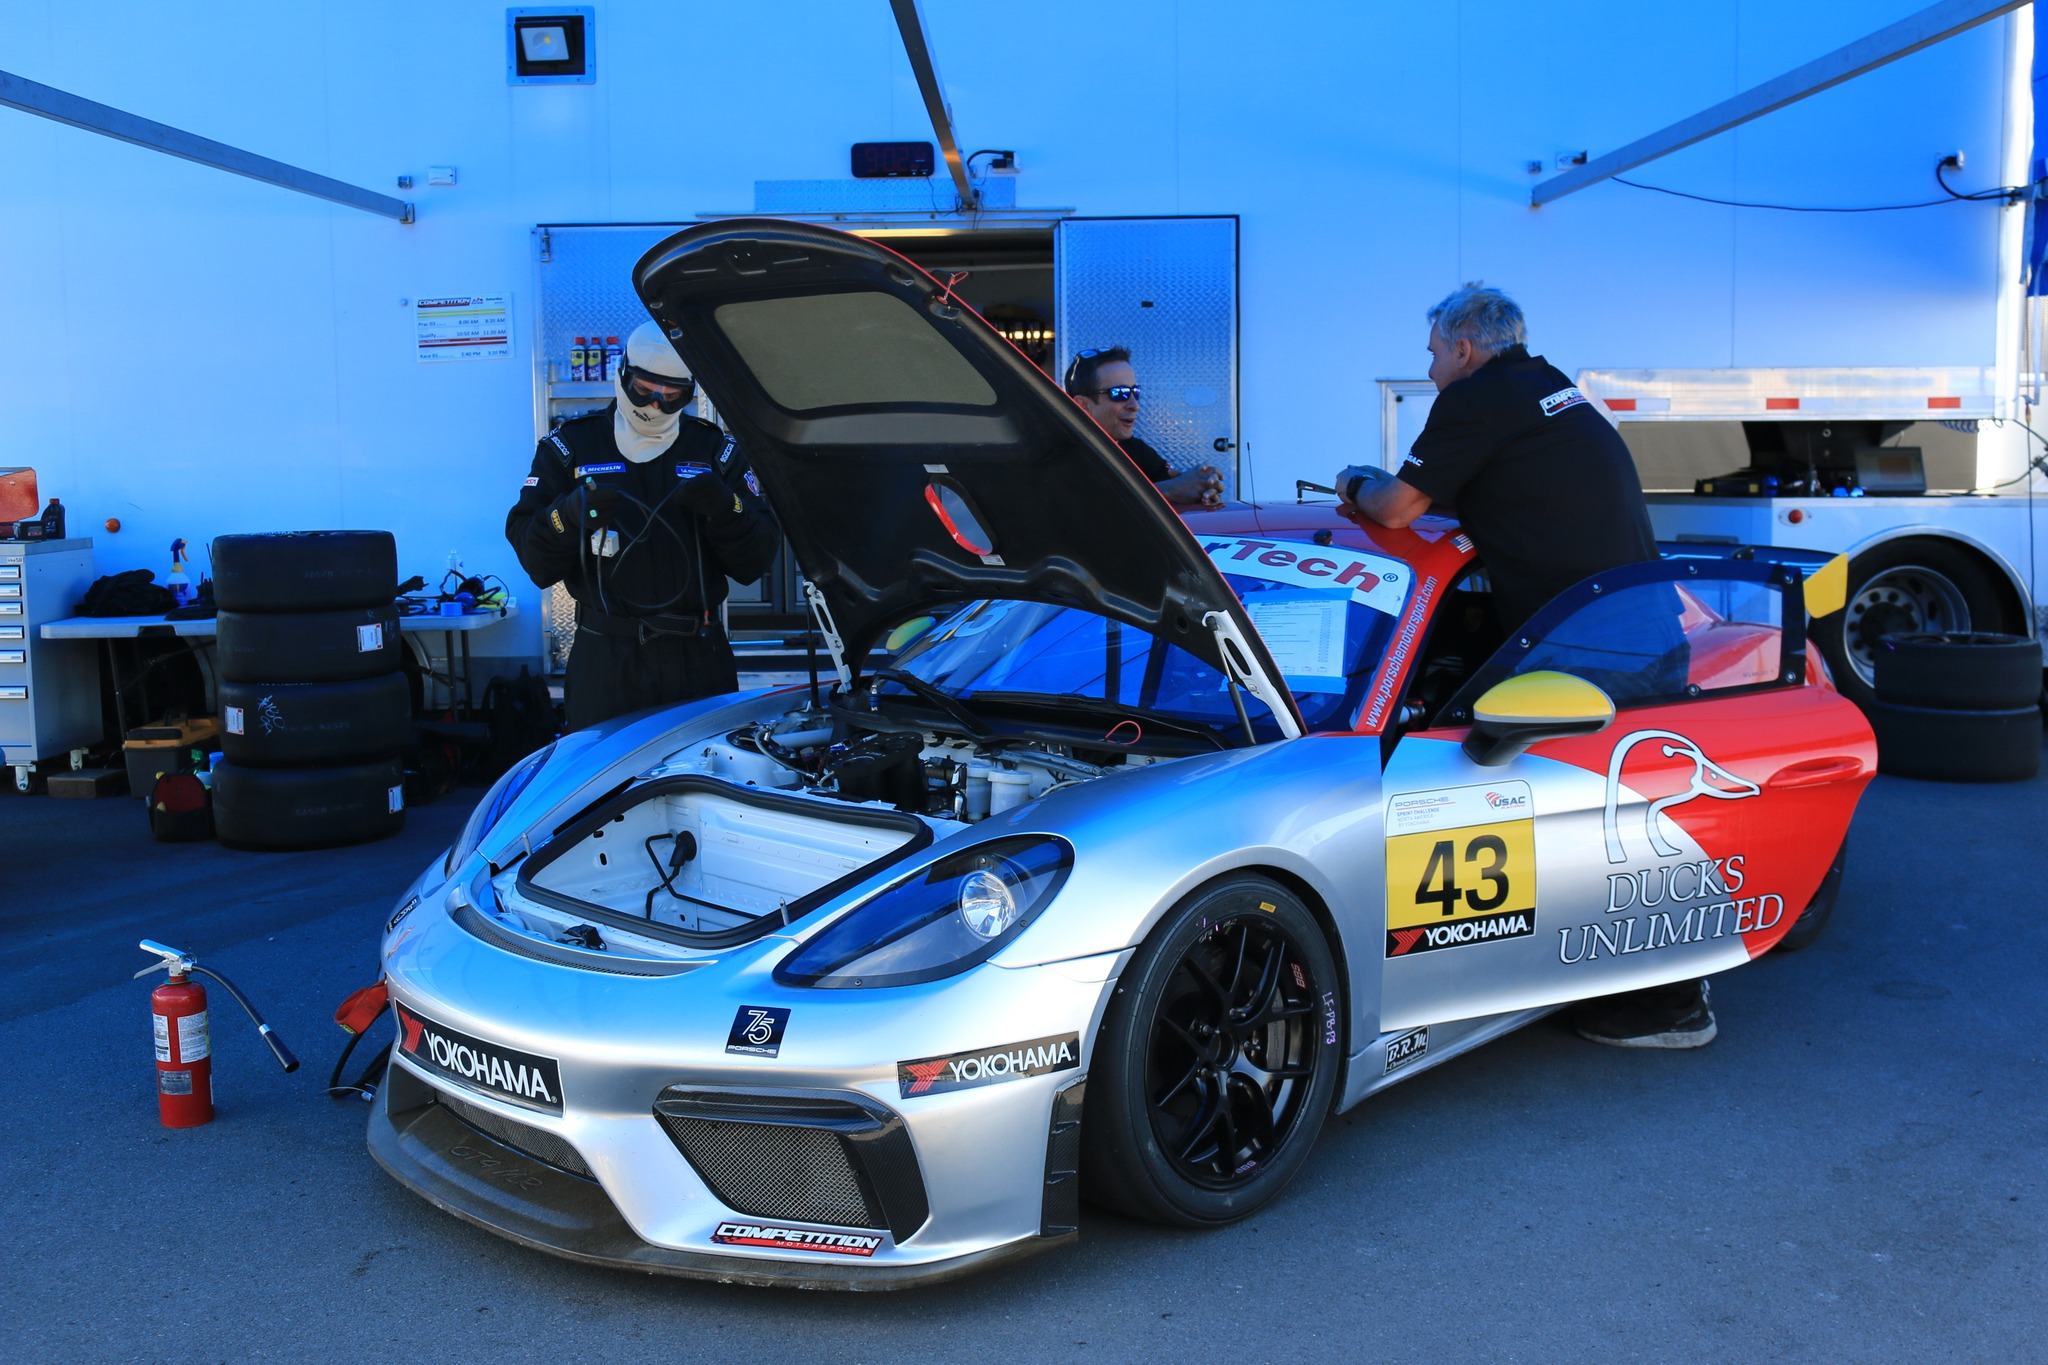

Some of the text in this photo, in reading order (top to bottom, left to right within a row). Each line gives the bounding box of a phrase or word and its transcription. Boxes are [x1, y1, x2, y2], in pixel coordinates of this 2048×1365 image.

[418, 298, 471, 307] COMPETITION
[1365, 575, 1438, 728] www.porschemotorsport.com
[1394, 796, 1449, 808] PORSCHE
[1413, 806, 1440, 815] CHALLENGE
[1494, 796, 1526, 807] USAC
[1415, 834, 1510, 917] 43
[1605, 855, 1745, 914] DUCKS
[1425, 915, 1528, 947] YOKOHAMA
[1558, 893, 1785, 964] UNLIMITED
[1291, 963, 1306, 988] BBS
[742, 1009, 775, 1045] 75
[727, 1044, 777, 1055] PORSCHE
[949, 1041, 1073, 1083] YOKOHAMA
[424, 1028, 552, 1103] YOKOHAMA
[716, 1223, 881, 1249] COMPETITION
[775, 1241, 870, 1254] MOTORSPORTS
